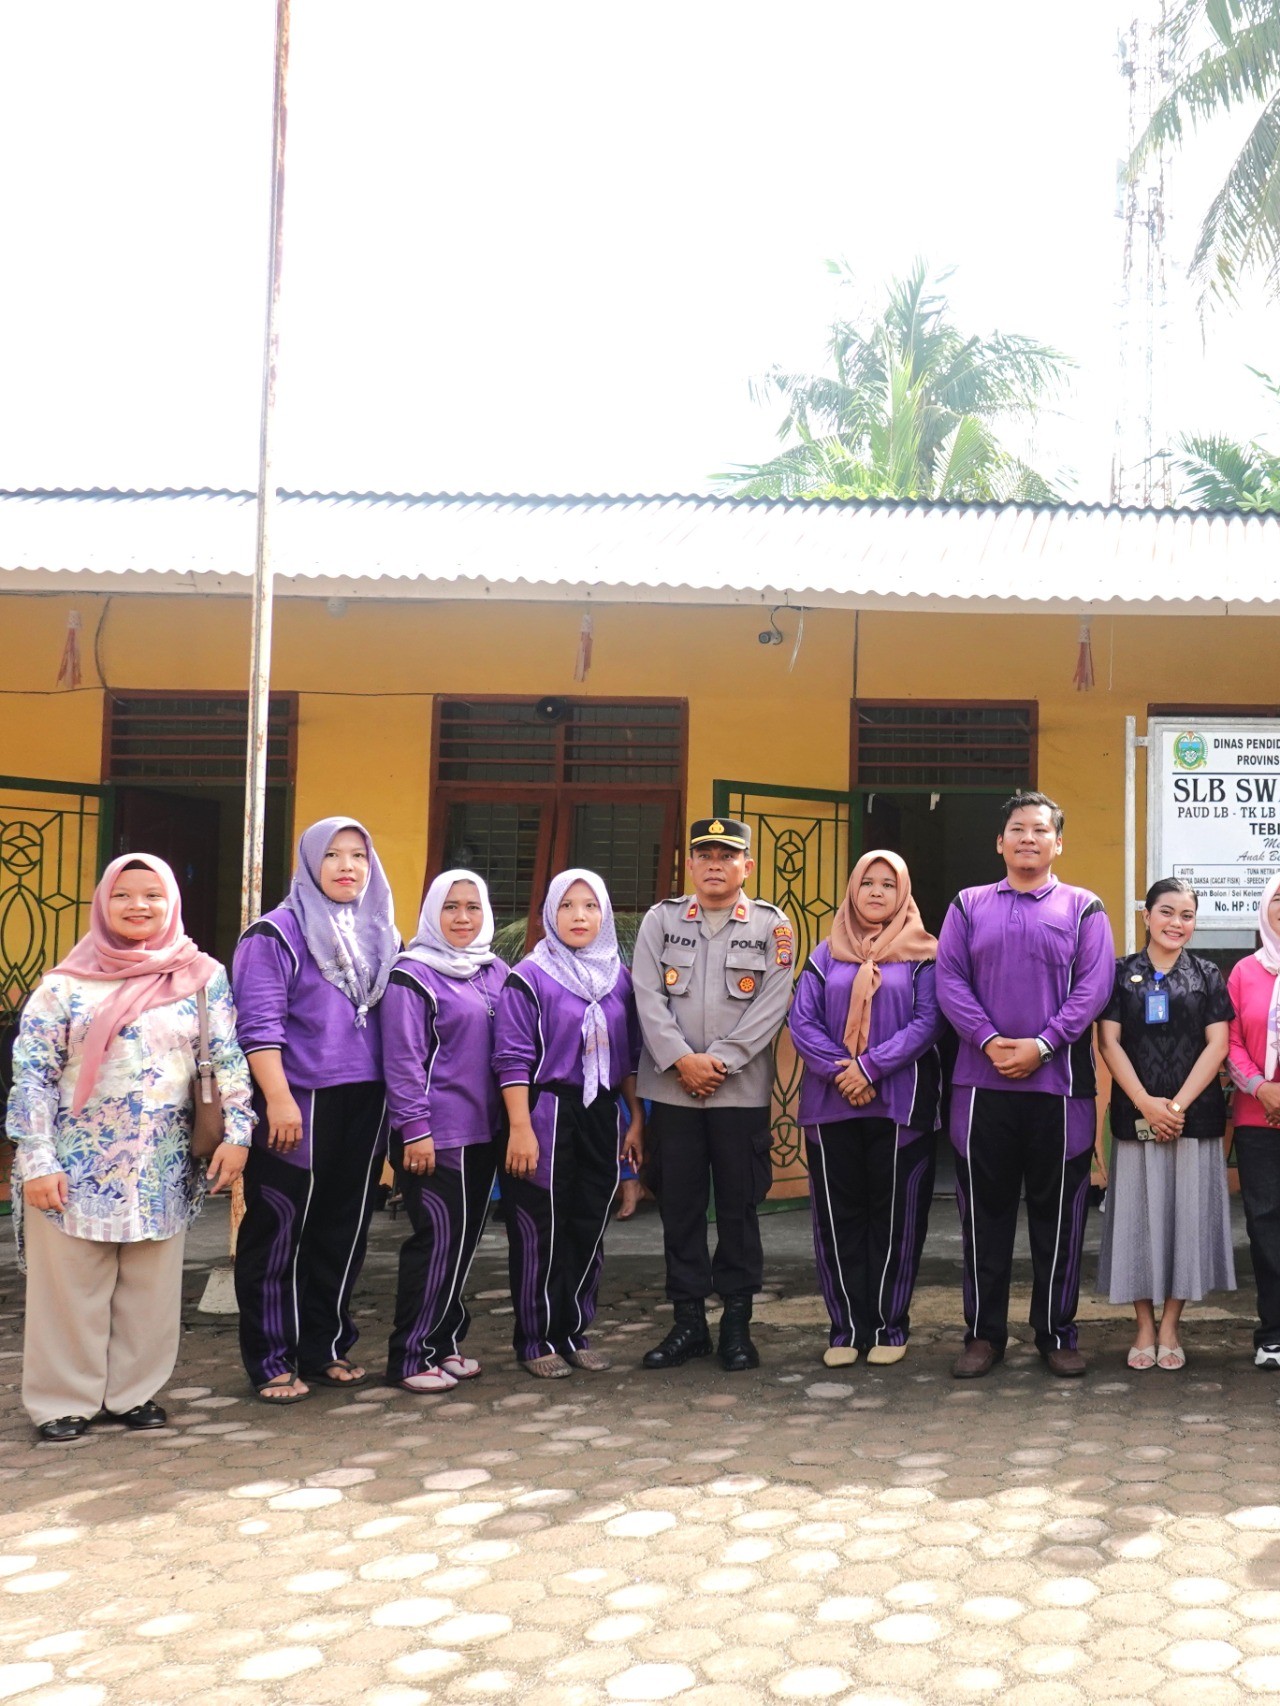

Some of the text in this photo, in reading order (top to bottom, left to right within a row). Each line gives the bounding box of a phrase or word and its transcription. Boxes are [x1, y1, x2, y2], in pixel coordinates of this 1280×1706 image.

[1213, 739, 1243, 749] DINAS
[1173, 778, 1226, 803] SLB
[1177, 806, 1210, 819] PAUD
[1213, 806, 1229, 819] LB
[1240, 806, 1257, 819] TK
[1261, 806, 1276, 819] LB
[1236, 850, 1265, 862] Anak
[1214, 900, 1230, 912] No.
[1231, 901, 1245, 912] HP
[730, 940, 767, 951] POLRI
